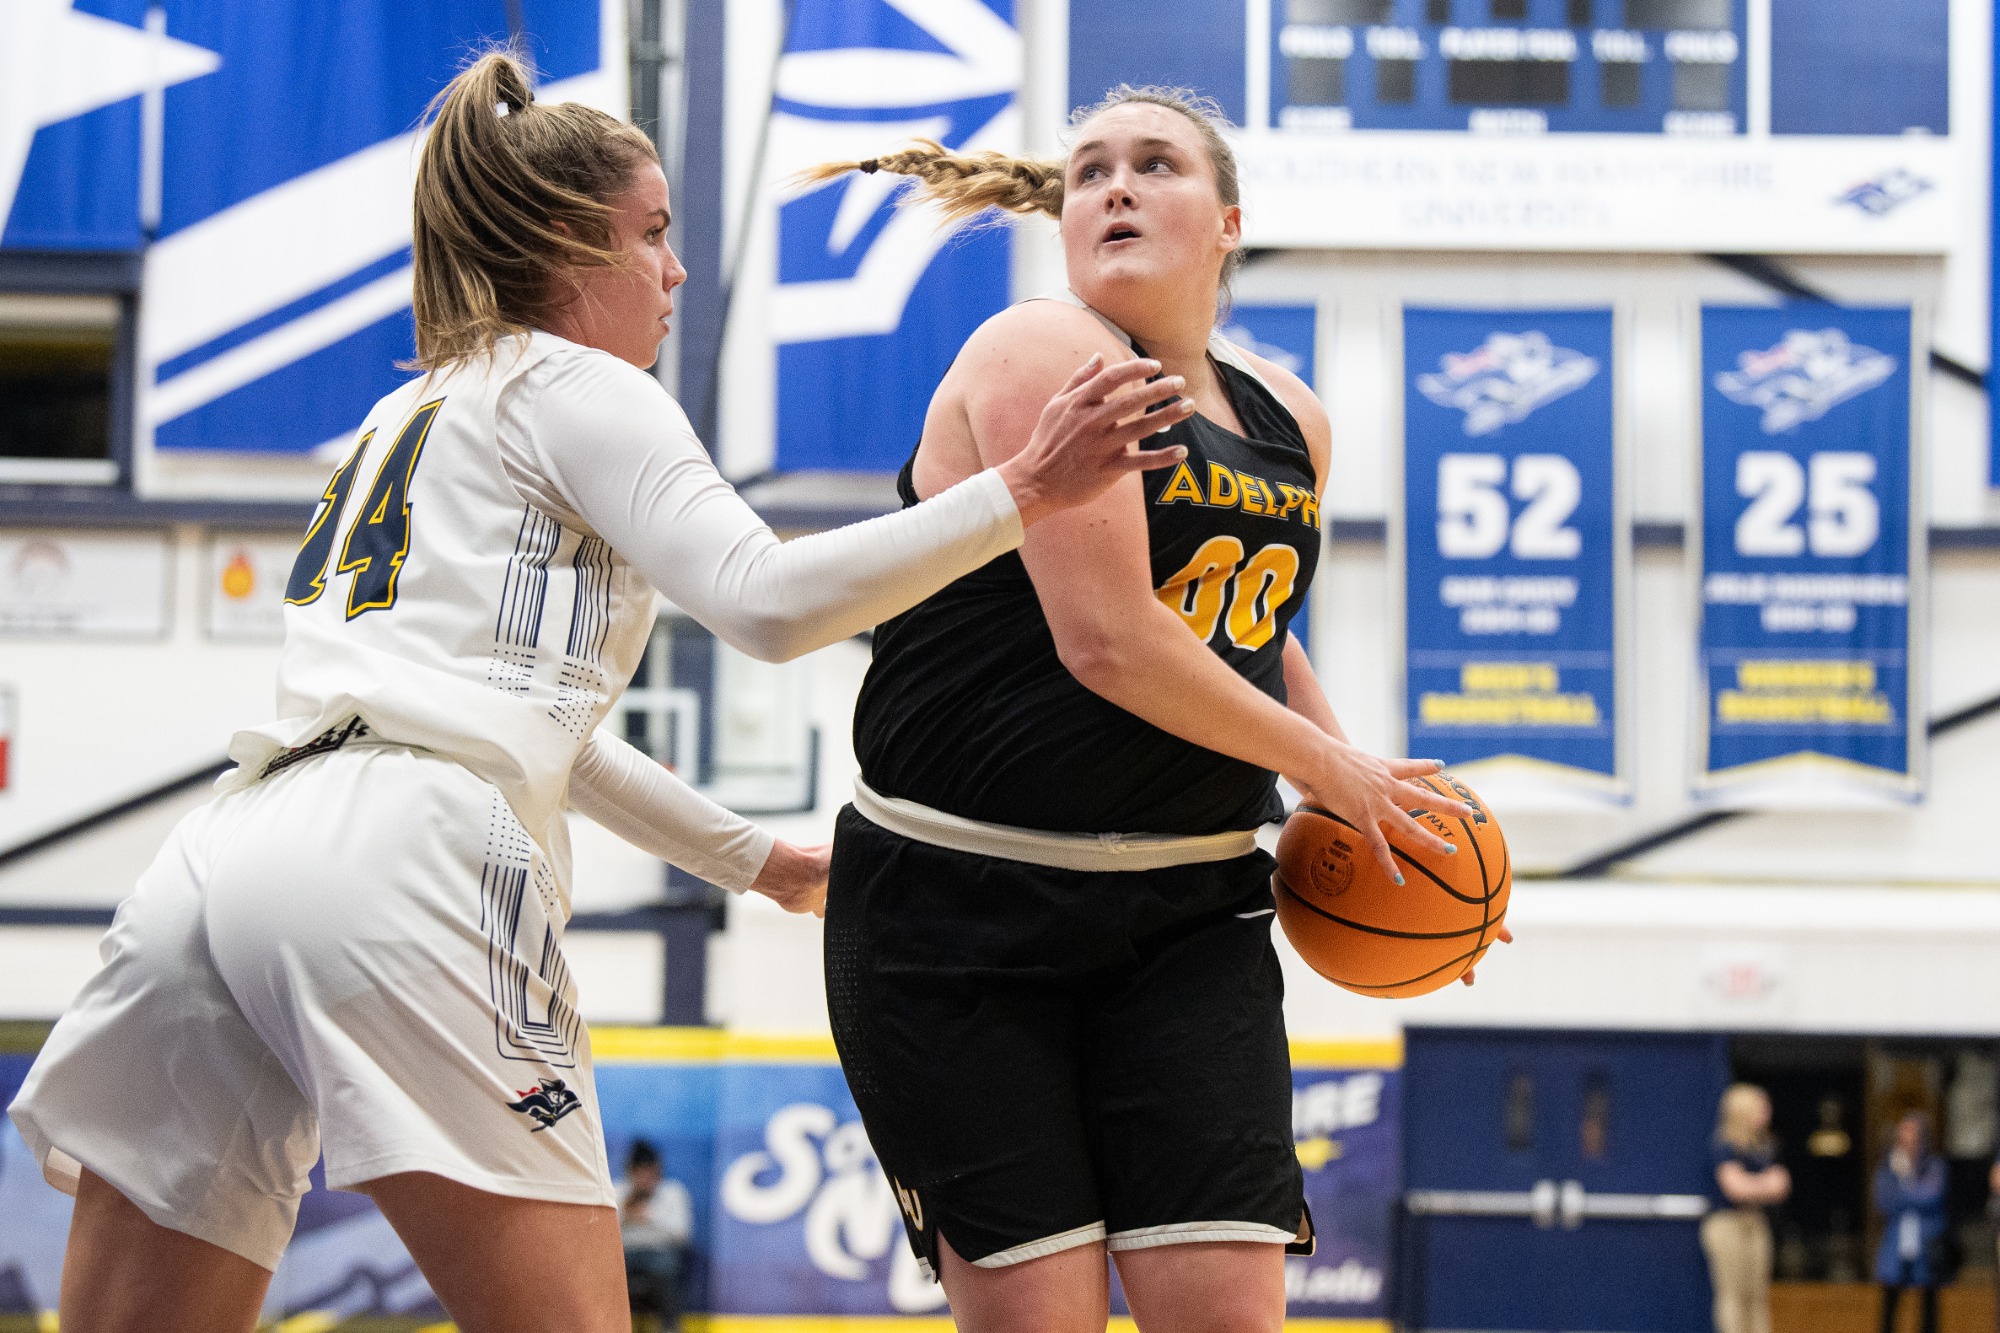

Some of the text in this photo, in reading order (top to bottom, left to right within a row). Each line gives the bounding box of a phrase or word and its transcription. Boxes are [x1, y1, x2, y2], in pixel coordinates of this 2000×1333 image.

[284, 395, 448, 623] 14
[1437, 452, 1582, 560] 52
[1734, 451, 1880, 557] 25
[1153, 535, 1300, 652] 00
[1426, 814, 1455, 838] NXT
